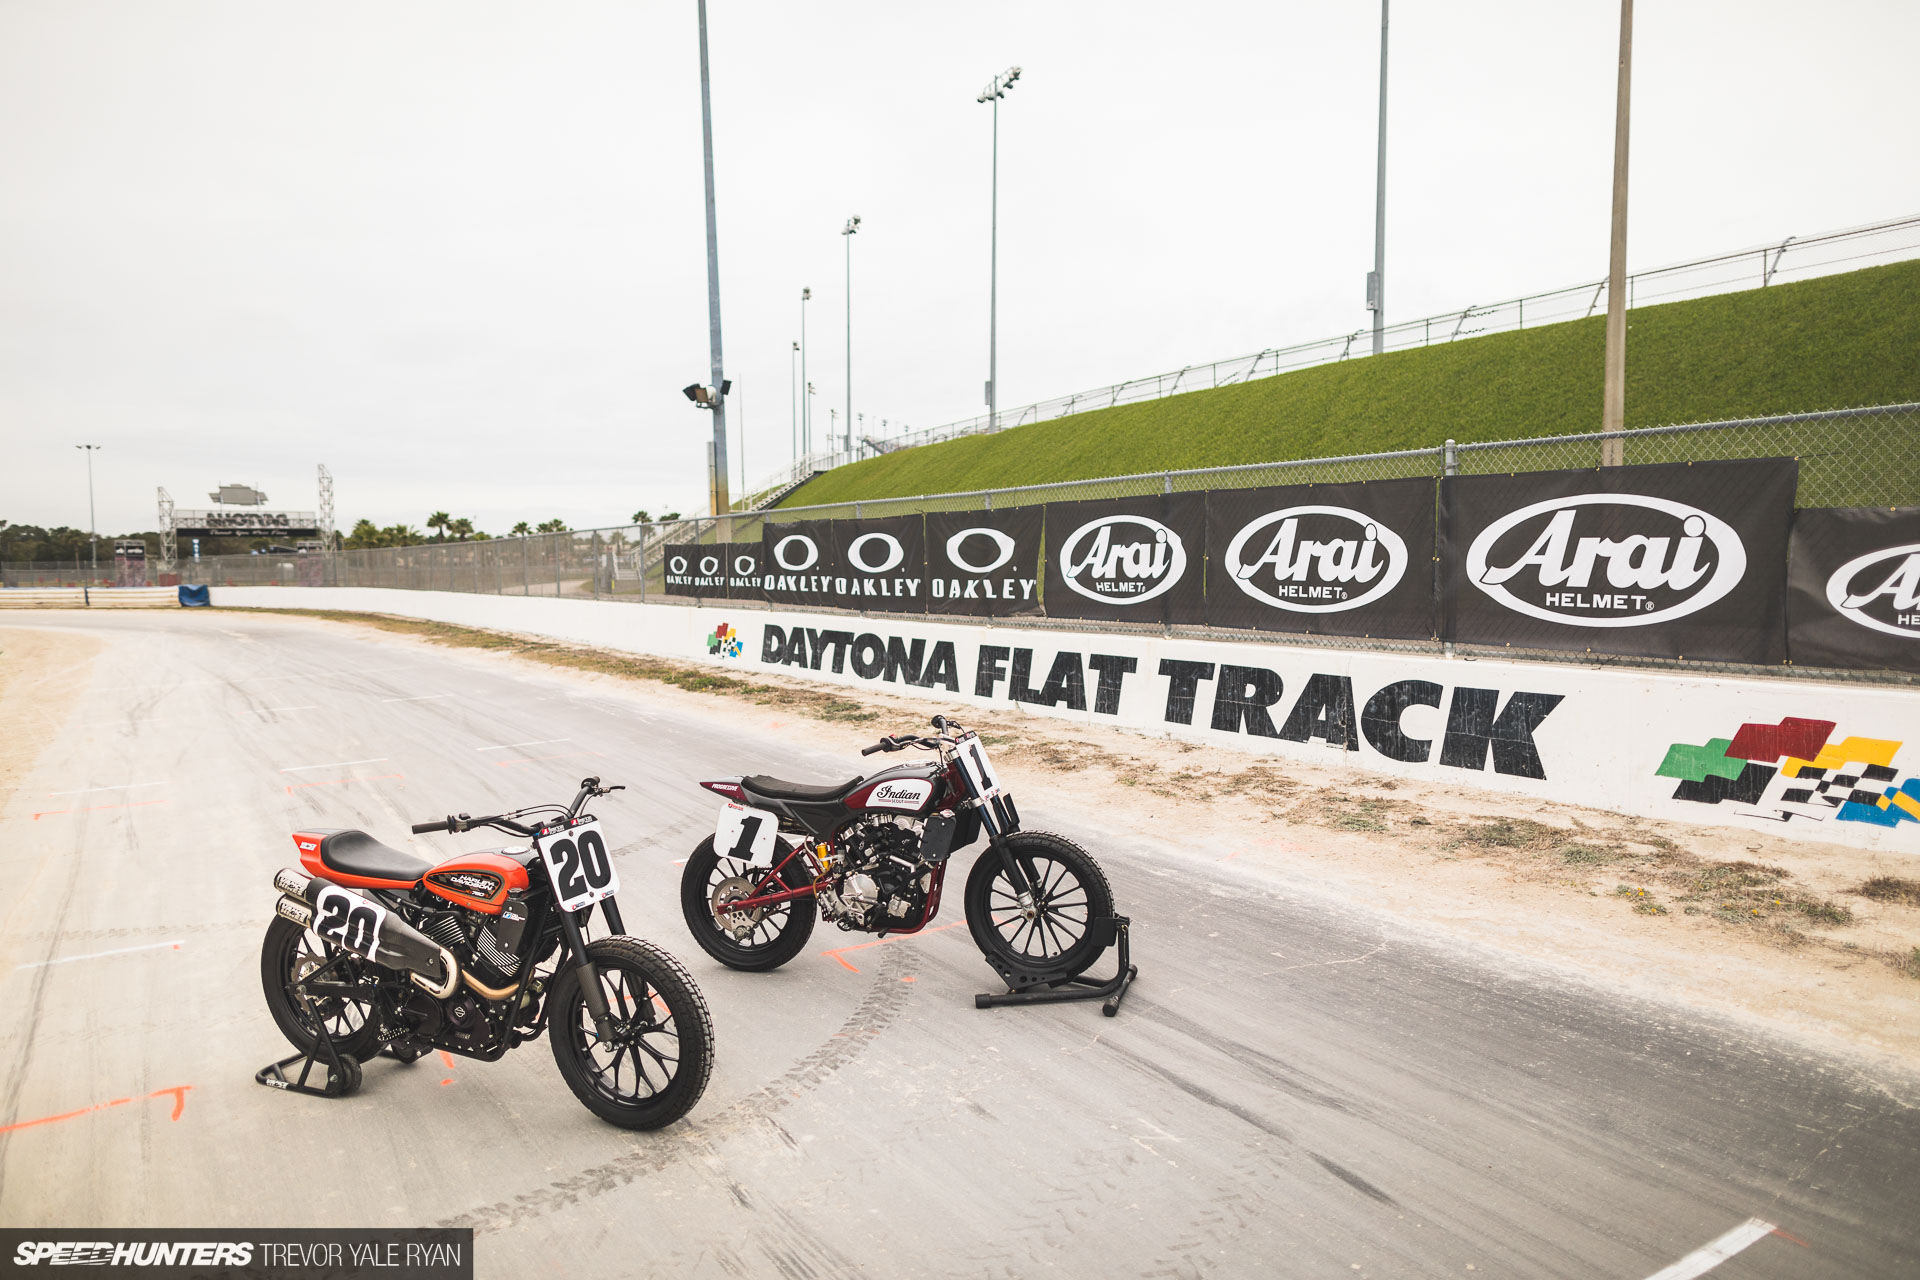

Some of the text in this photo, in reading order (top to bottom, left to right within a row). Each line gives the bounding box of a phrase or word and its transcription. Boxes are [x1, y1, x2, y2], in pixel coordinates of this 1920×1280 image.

[1066, 526, 1170, 579] Arai
[1236, 518, 1384, 583] Arai
[1479, 510, 1711, 590] Arai
[694, 576, 725, 586] OAKLEY
[729, 577, 761, 587] OAKLEY
[764, 574, 830, 592] OAKLEY
[835, 577, 920, 597] OAKLEY
[932, 579, 1034, 600] OAKLEY
[1096, 582, 1144, 593] HELMET
[1278, 585, 1343, 599] HELMET
[1545, 592, 1647, 610] HELMET
[761, 624, 1566, 780] DAYTONA FLAT TRACK
[969, 744, 993, 791] 1
[876, 785, 921, 800] Indian
[728, 815, 763, 861] 1
[550, 830, 611, 902] 20
[317, 894, 377, 957] 20
